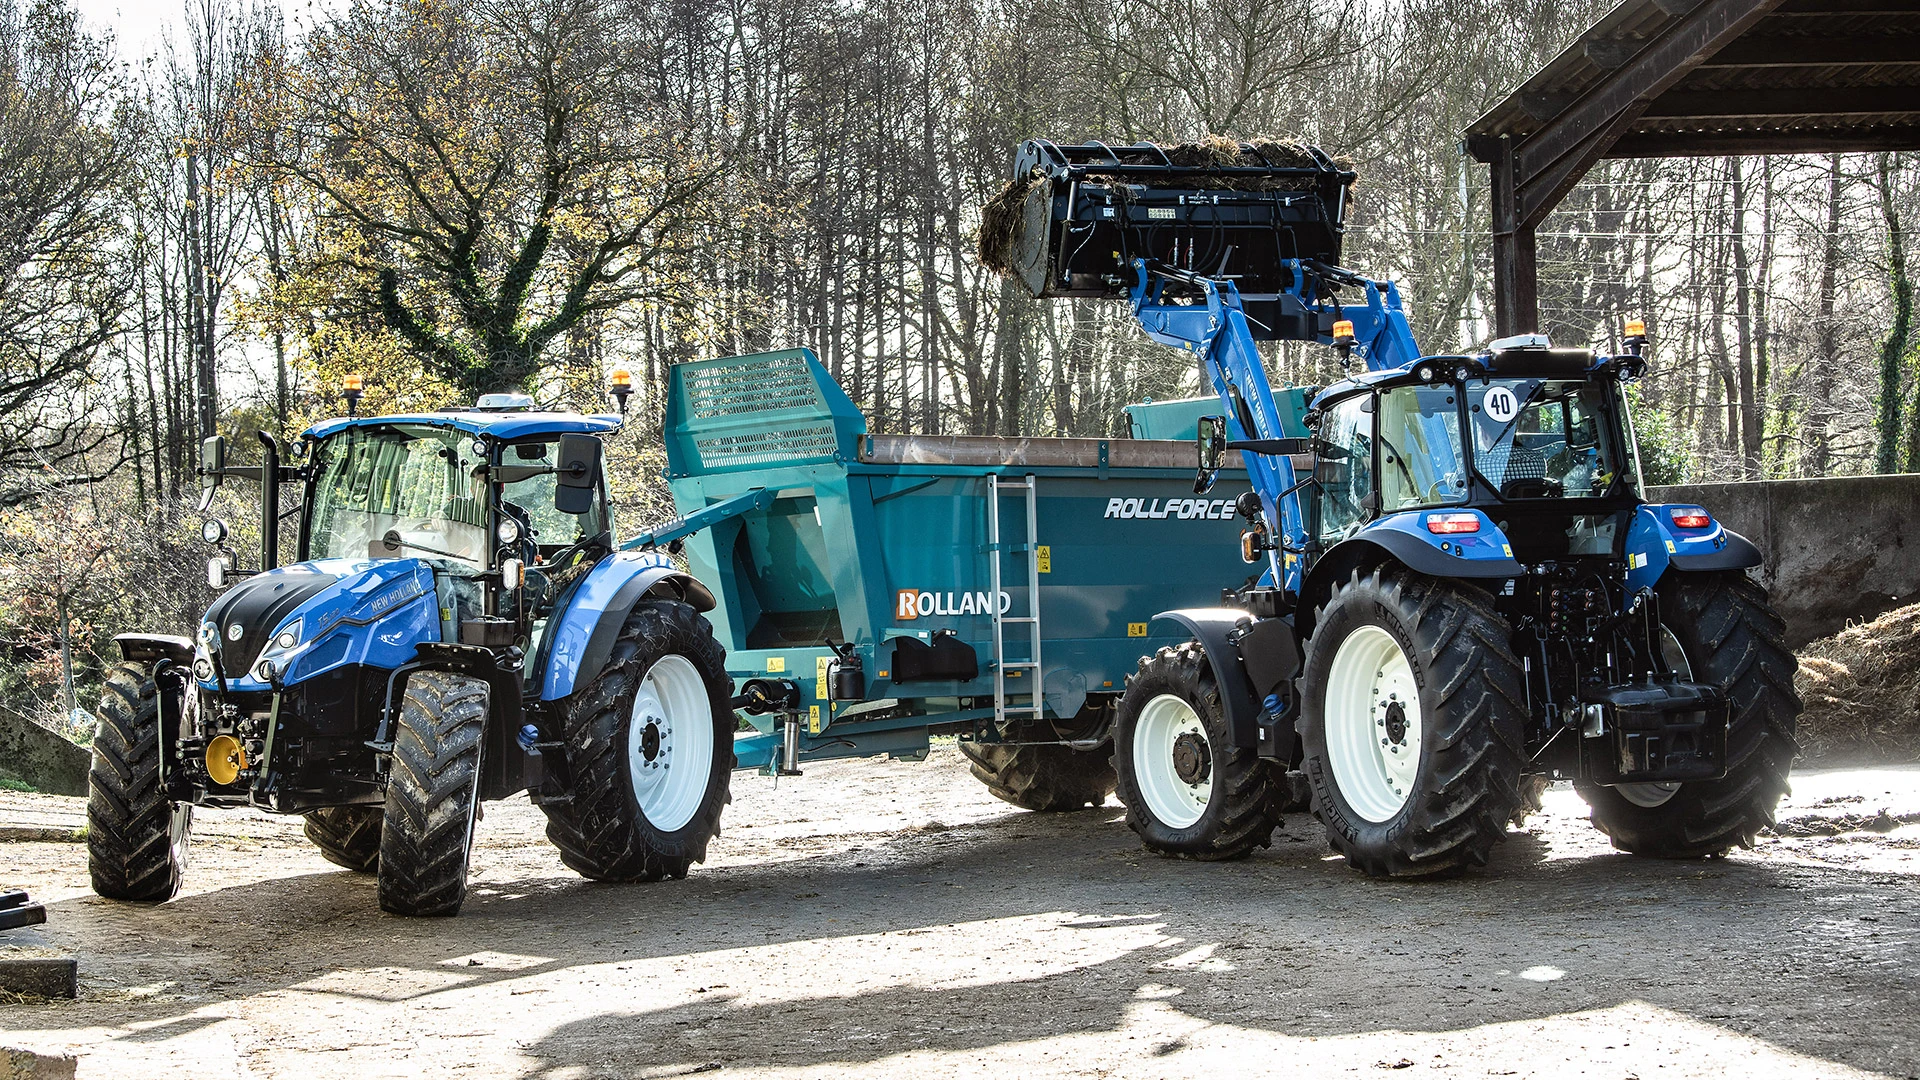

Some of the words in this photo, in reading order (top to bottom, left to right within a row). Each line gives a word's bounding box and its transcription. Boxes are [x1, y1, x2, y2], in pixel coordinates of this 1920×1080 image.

[1245, 374, 1258, 402] NEW
[1255, 402, 1271, 440] HOLLA
[1491, 394, 1510, 415] 40
[1104, 497, 1237, 520] ROLLFORCE
[371, 599, 389, 612] NEW
[389, 578, 421, 603] HOLLAND
[899, 591, 1012, 617] ROLLAND
[1386, 610, 1425, 687] MICHELIN
[1309, 757, 1348, 836] MICHELIN
